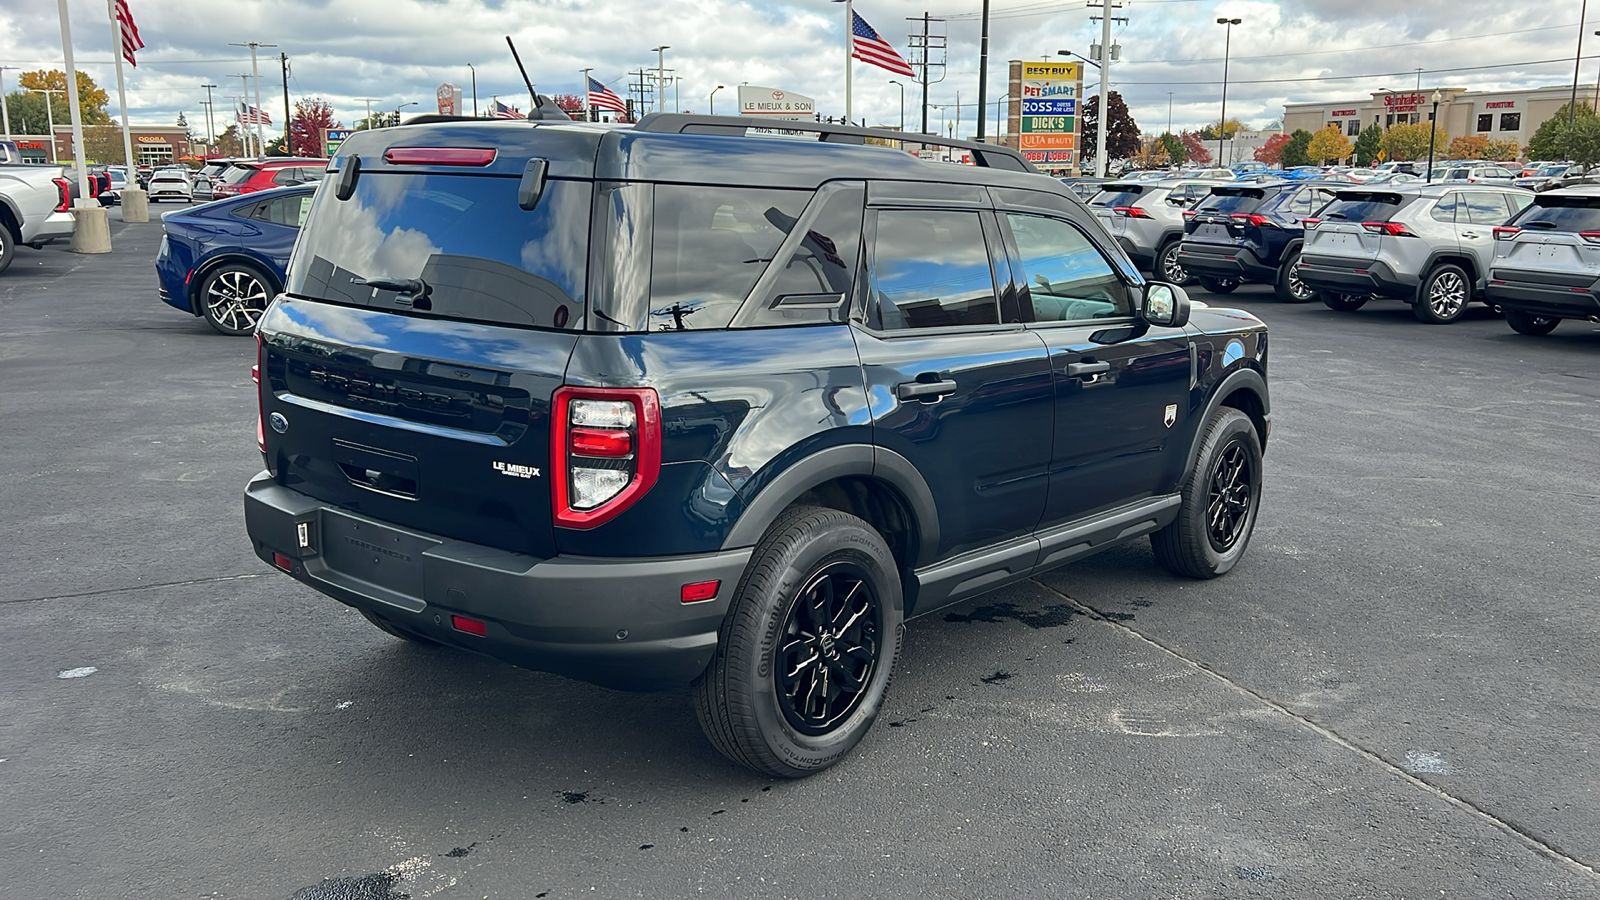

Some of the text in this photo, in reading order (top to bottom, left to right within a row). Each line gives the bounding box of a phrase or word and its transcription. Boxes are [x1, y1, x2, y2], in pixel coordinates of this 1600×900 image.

[745, 102, 812, 111] LE MIEUX & SON
[1023, 102, 1052, 111] ROSS
[1032, 117, 1064, 128] DICK'S
[1025, 136, 1046, 144] ULTA
[1048, 152, 1072, 161] LOBBY
[493, 461, 541, 477] LE MIEUX
